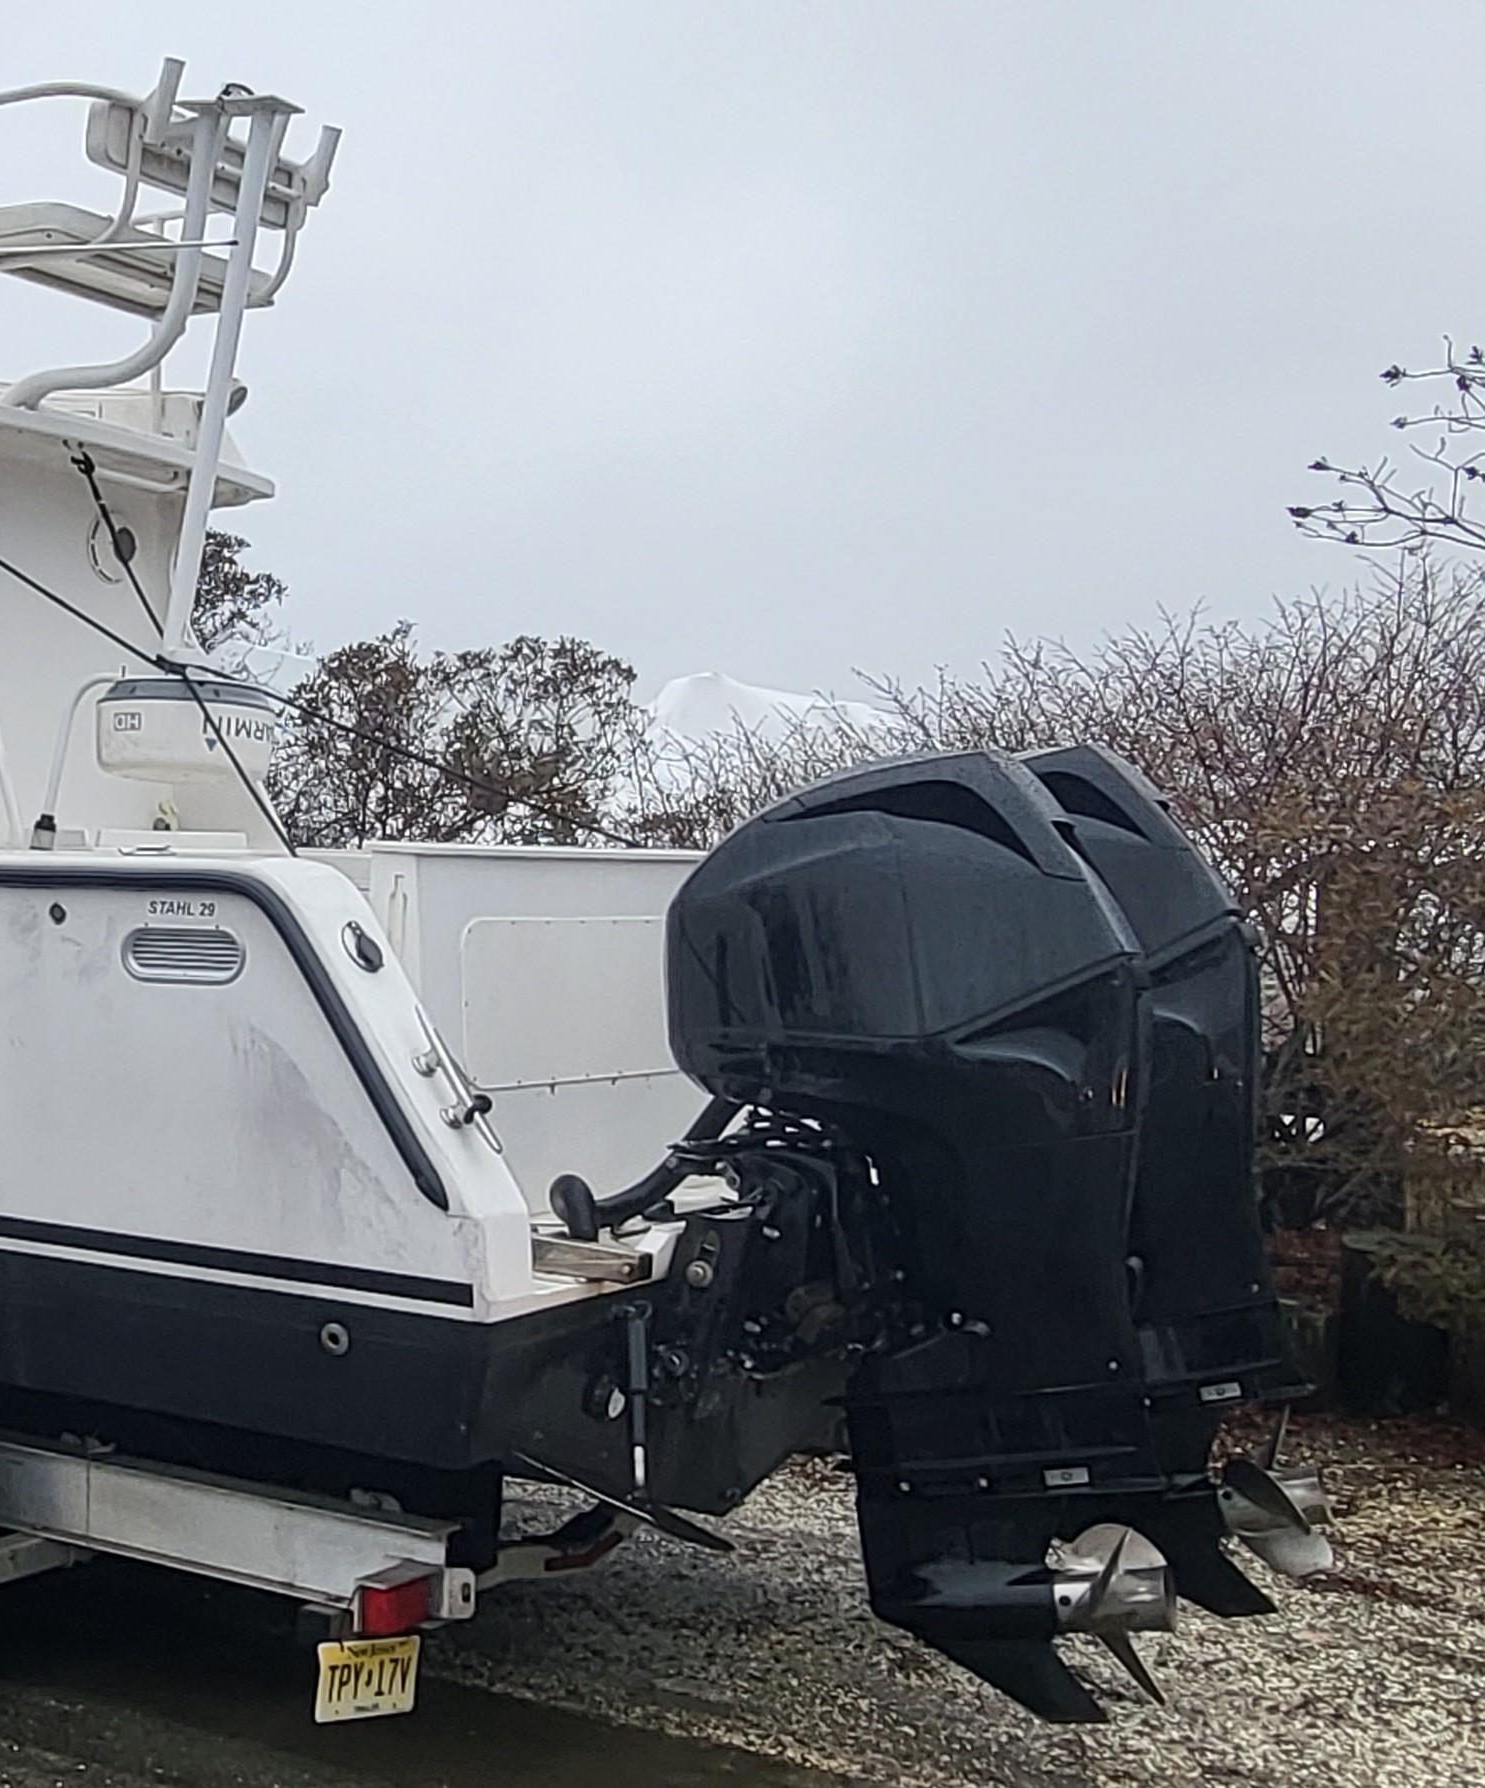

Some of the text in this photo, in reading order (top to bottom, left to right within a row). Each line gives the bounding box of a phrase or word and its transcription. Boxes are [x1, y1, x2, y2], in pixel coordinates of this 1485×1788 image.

[115, 713, 141, 730] HD
[148, 901, 216, 918] STAHL 29
